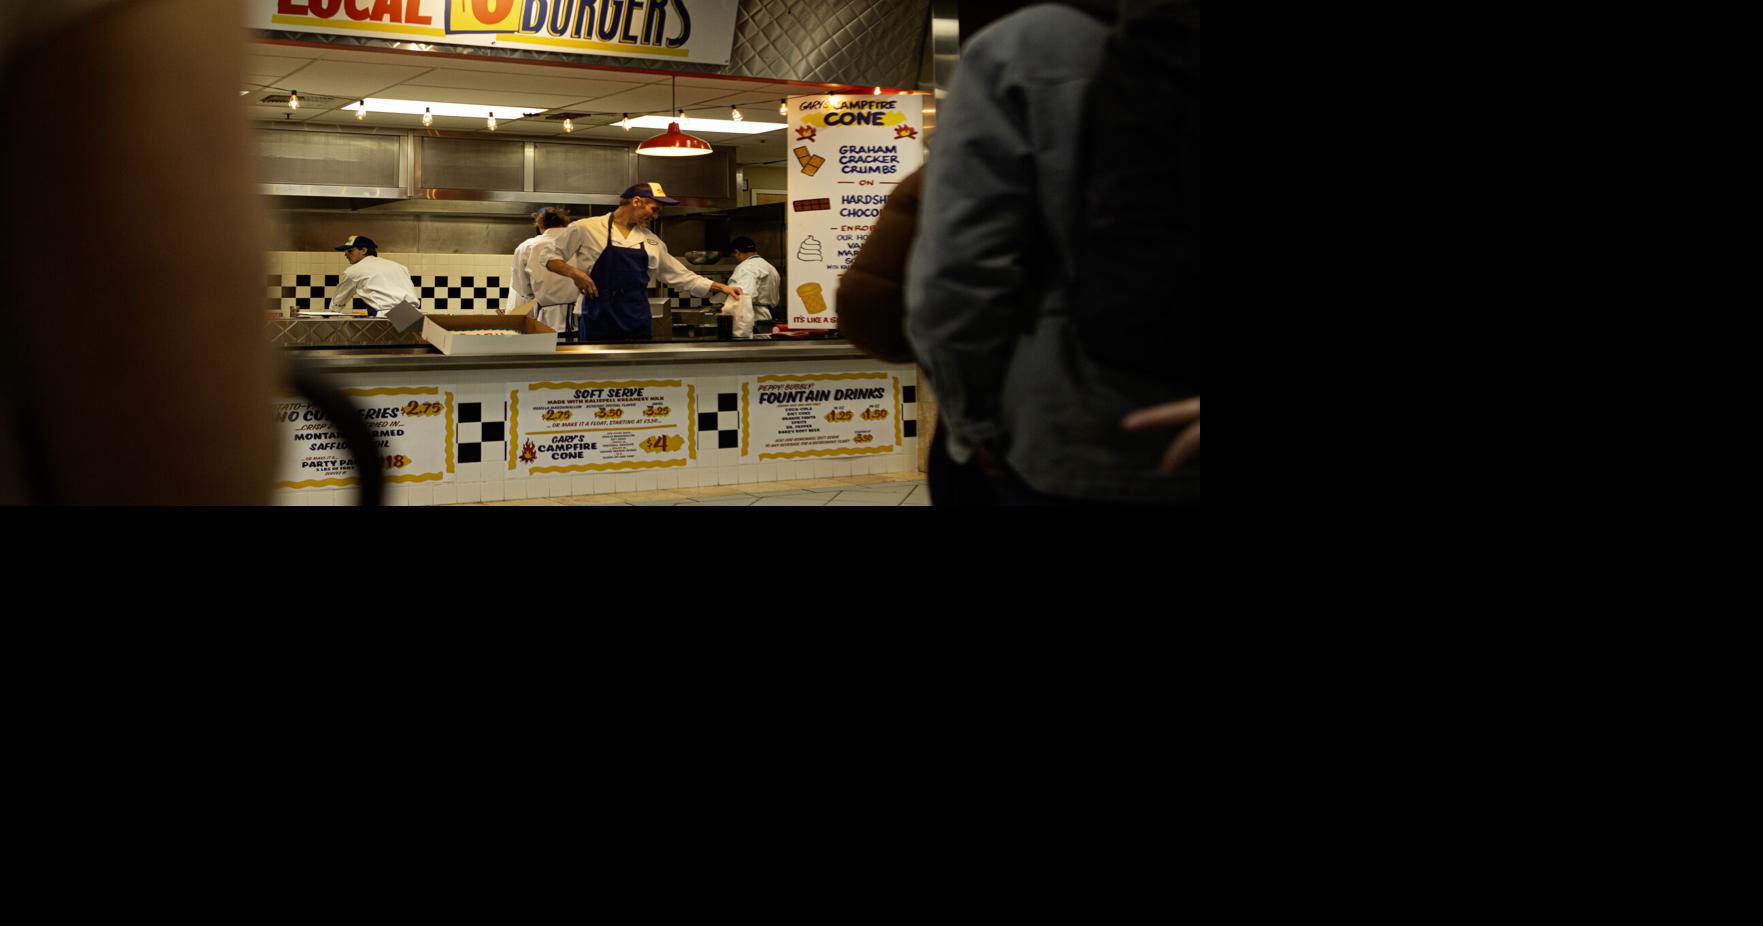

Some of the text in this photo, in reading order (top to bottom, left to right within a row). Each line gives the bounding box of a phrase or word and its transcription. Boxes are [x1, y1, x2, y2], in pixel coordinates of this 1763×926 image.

[823, 111, 886, 126] CONE
[839, 145, 897, 154] GRAHAM
[839, 155, 899, 164] CRACKER
[841, 165, 897, 174] CRUMBS
[841, 195, 888, 204] HARDSH
[840, 208, 881, 217] CHOCO
[574, 387, 645, 398] SOFT SERVE
[759, 387, 885, 404] FOUNTAIN DRINKS
[359, 407, 400, 419] FRIES
[400, 401, 441, 415] $2.75
[294, 432, 344, 440] MONTAN
[551, 435, 585, 444] GARY'S
[309, 442, 351, 450] SAFFLO
[537, 442, 598, 452] CAMPFIRE
[646, 434, 667, 452] $4
[551, 451, 584, 460] CONE
[302, 460, 337, 468] PARTY
[339, 459, 357, 467] PA
